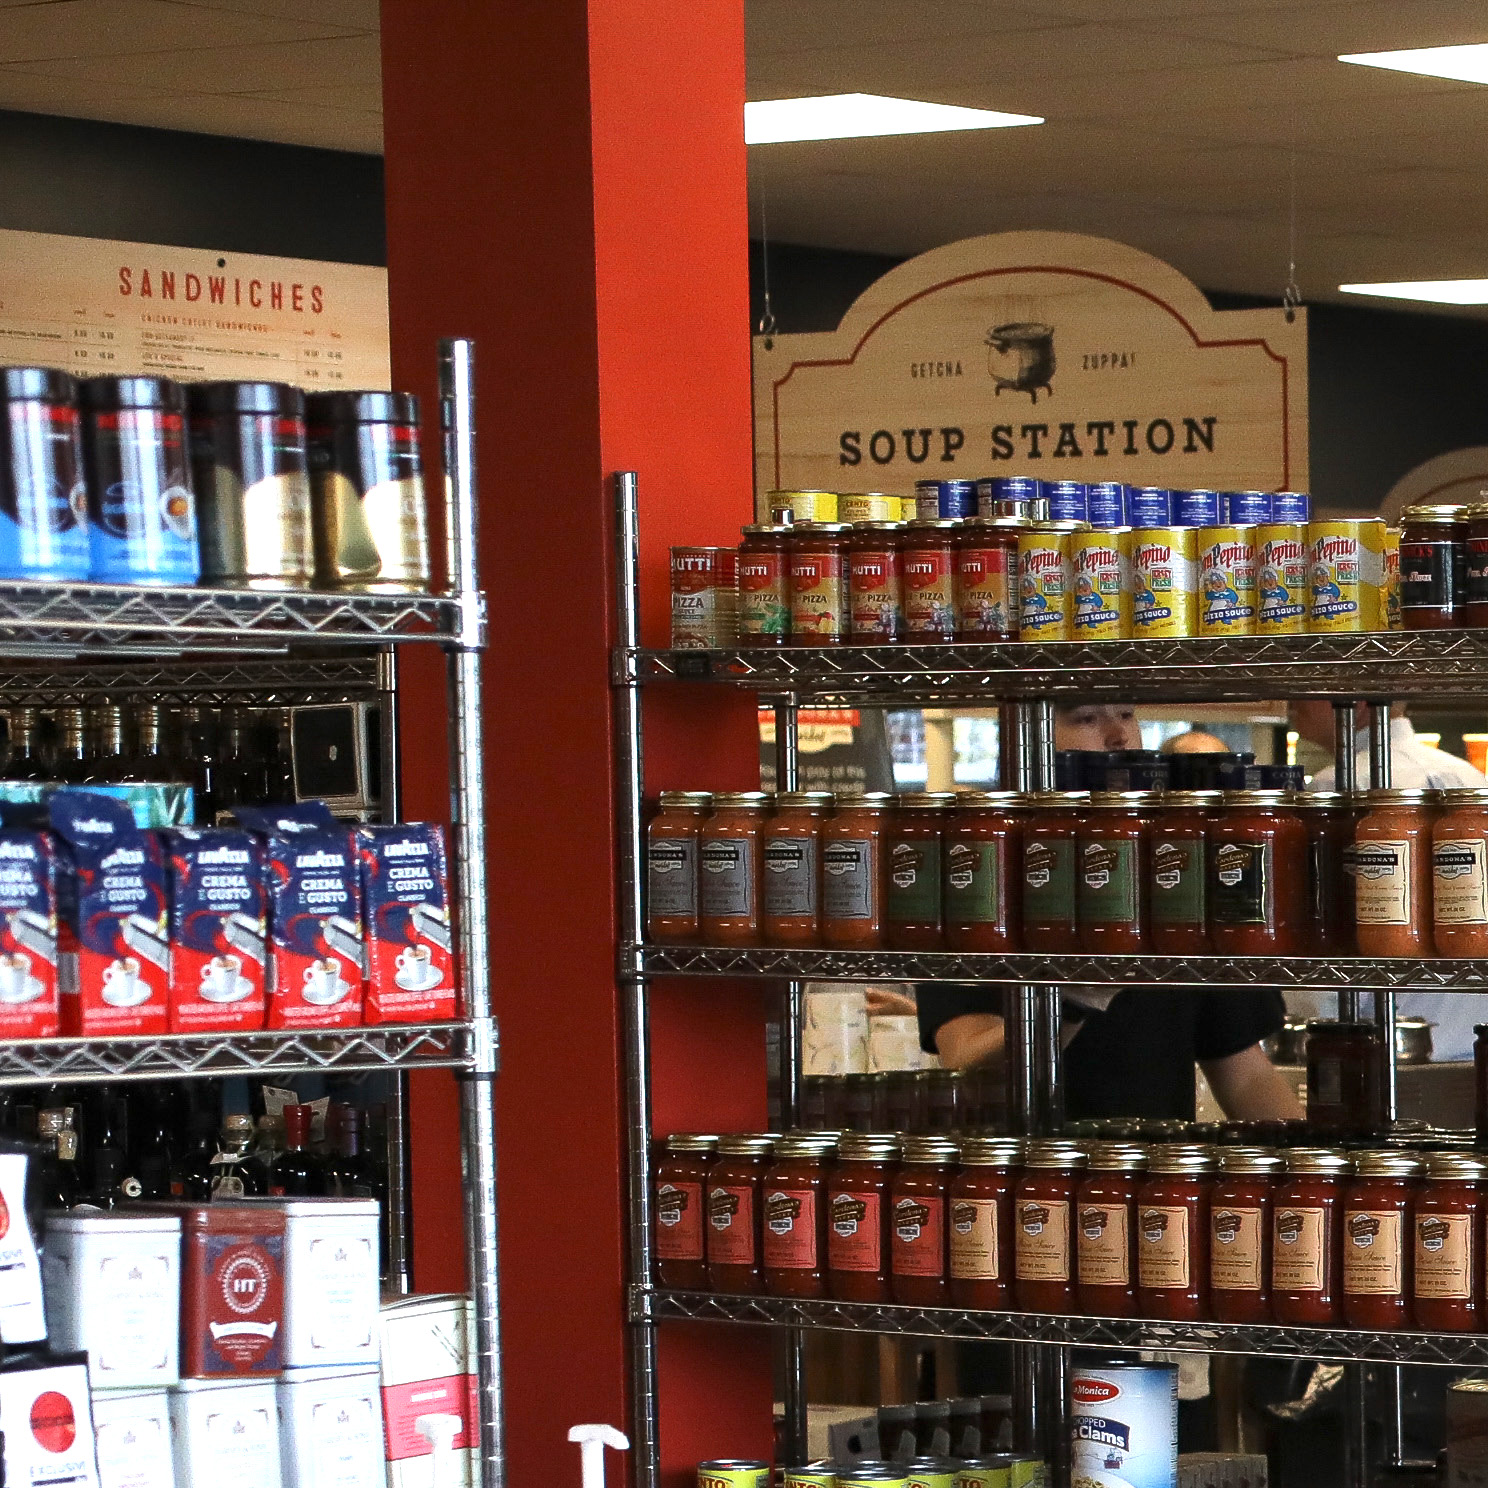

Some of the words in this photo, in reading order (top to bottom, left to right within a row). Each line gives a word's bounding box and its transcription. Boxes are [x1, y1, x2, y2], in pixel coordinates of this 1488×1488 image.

[118, 266, 325, 314] SANDWICHES
[910, 360, 963, 379] GETCHA
[838, 427, 965, 466] SOUP
[990, 416, 1218, 460] STATION
[754, 594, 780, 603] PIZZA
[802, 594, 828, 603] PIZZA
[867, 593, 892, 603] PIZZA
[919, 592, 945, 601] PIZZA
[969, 591, 993, 600] PIZZA
[1224, 608, 1252, 616] sauce
[1276, 606, 1303, 615] sauce
[1327, 603, 1354, 613] sauce
[1034, 612, 1060, 622] sauce
[1090, 611, 1117, 621] sauce
[1143, 609, 1168, 618] sauce
[389, 866, 430, 879] CREMA
[300, 879, 344, 891] CREMA
[395, 879, 434, 892] GUSTO
[1073, 1416, 1106, 1429] HOPPED
[1079, 1425, 1125, 1448] Clams
